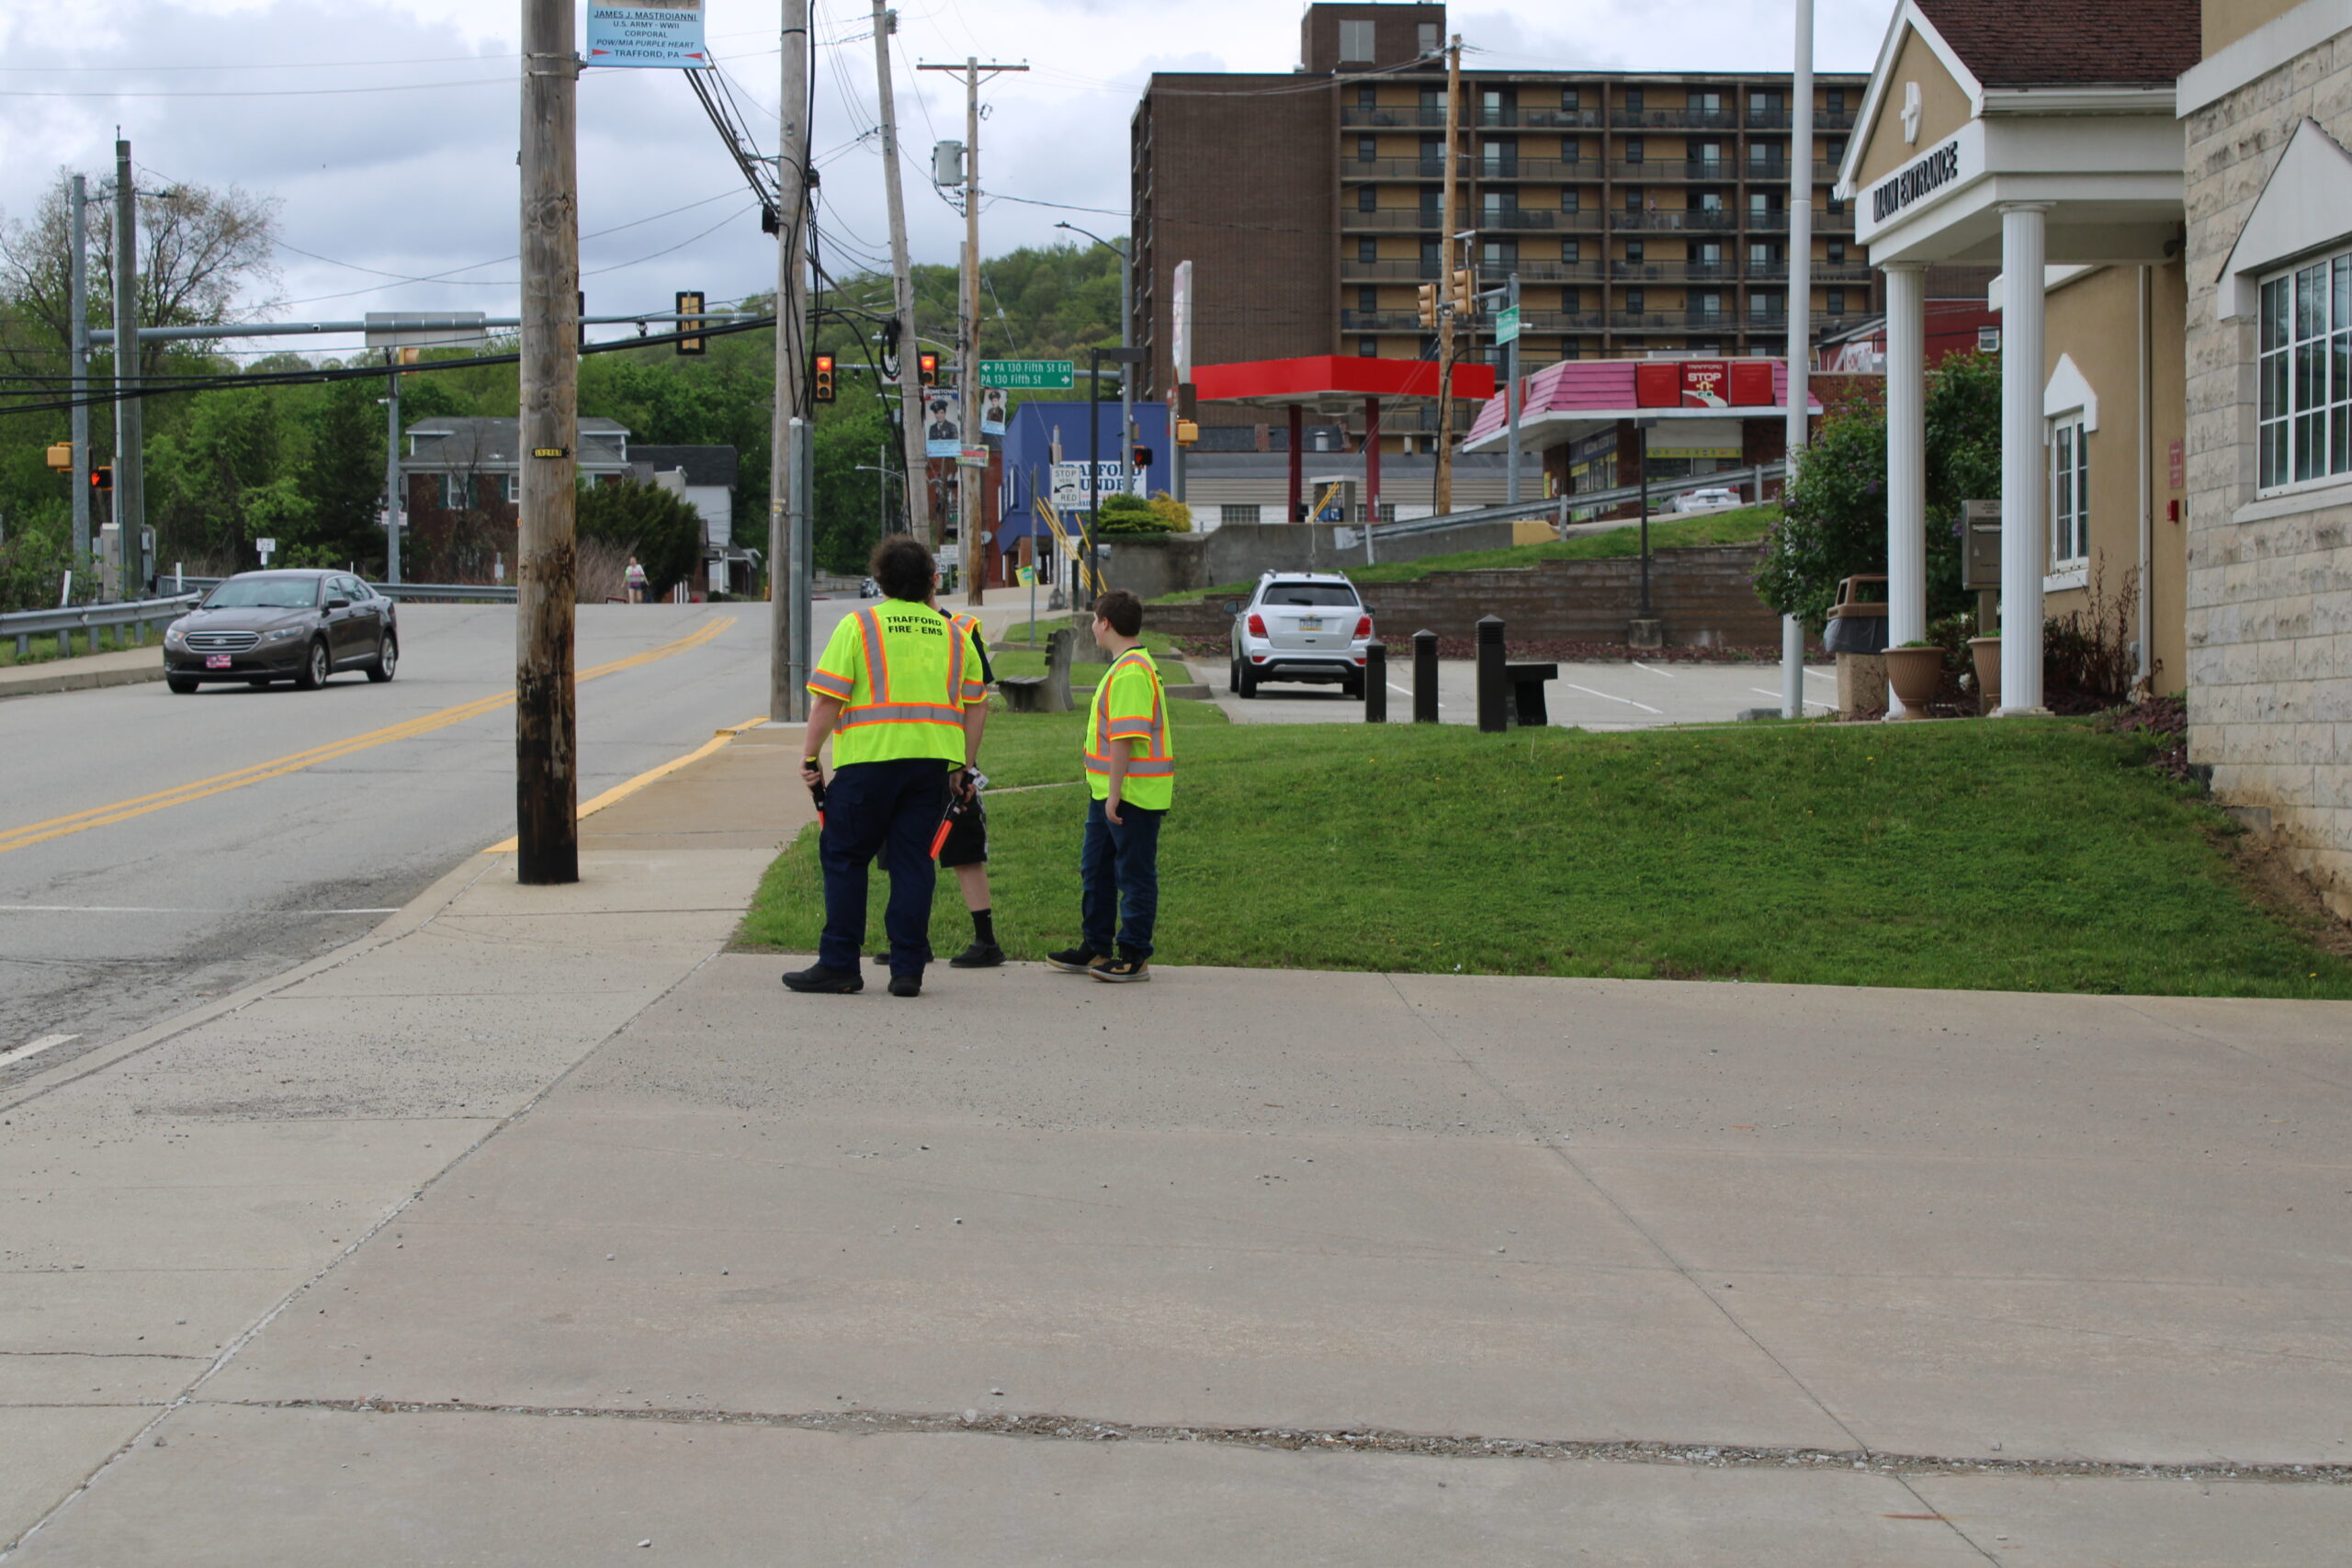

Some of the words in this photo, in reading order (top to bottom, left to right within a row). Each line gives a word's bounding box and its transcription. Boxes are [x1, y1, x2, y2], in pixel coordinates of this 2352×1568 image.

[594, 10, 624, 19] JAMES
[625, 11, 632, 19] J.
[635, 12, 697, 22] MASTROIANNI
[625, 30, 668, 39] CORPORAL
[597, 39, 634, 47] POW/MIA
[635, 39, 667, 48] PURPLE
[667, 40, 695, 49] HEART
[615, 50, 665, 59] TRAFFORD,
[667, 51, 680, 59] PA
[1873, 177, 1899, 223] MAIN
[1900, 141, 1958, 208] ENTRANCE
[994, 363, 1005, 372] PA
[1008, 363, 1022, 372] 130
[1023, 363, 1044, 373] Fifth
[1046, 363, 1055, 373] St
[1057, 363, 1070, 373] Ext
[981, 375, 991, 384] PA
[994, 375, 1008, 384] 130
[1011, 375, 1030, 384] Fifth
[1033, 375, 1041, 384] St
[1688, 372, 1722, 382] STOP
[1058, 464, 1142, 476] AFOD
[886, 616, 942, 626] TRAFFORD
[922, 626, 943, 636] EMS
